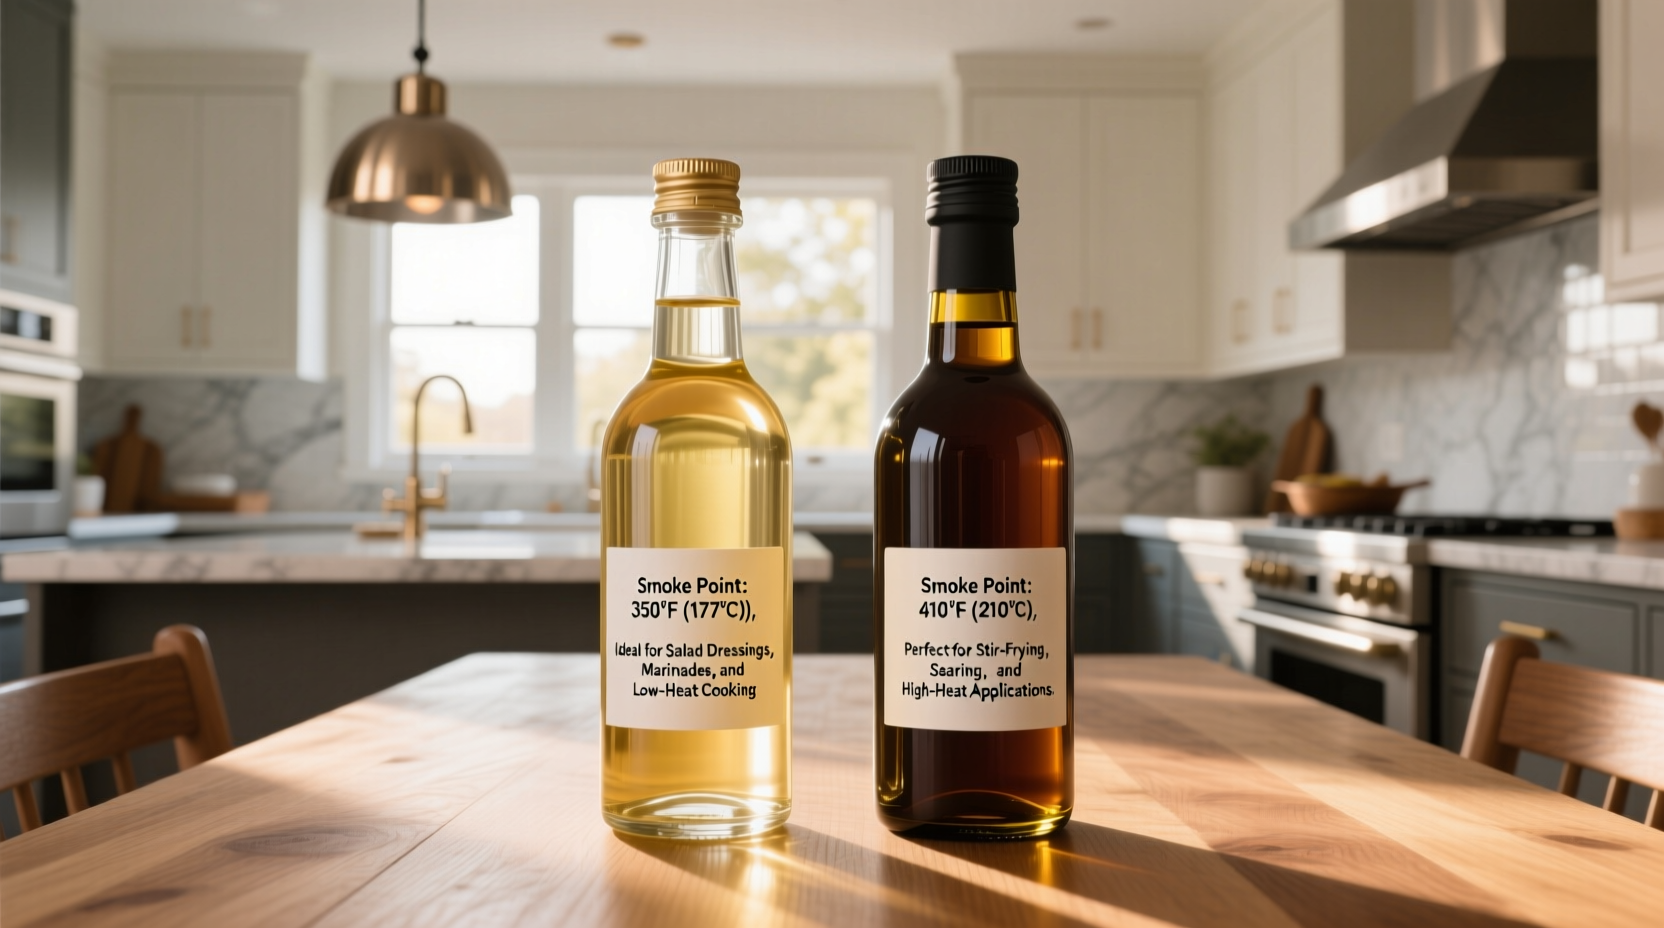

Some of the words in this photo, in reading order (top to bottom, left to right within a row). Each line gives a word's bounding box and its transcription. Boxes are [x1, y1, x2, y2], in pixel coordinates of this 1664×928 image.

[637, 576, 692, 594] Smoke
[696, 576, 748, 594] Point:
[921, 576, 979, 594] Smoke
[983, 576, 1032, 594] Point:
[615, 642, 642, 657] Ideal
[645, 642, 664, 658] for
[665, 643, 703, 658] Salad
[706, 642, 775, 660] Dressings,
[904, 642, 951, 658] Perfect
[951, 642, 973, 658] for
[976, 642, 1050, 661] Stir-Frying,
[641, 662, 717, 680] Marinades,
[719, 662, 745, 677] and
[996, 662, 1023, 677] and
[633, 682, 700, 698] Low-Heat
[701, 682, 757, 700] Cooking
[902, 682, 968, 700] High-Heat
